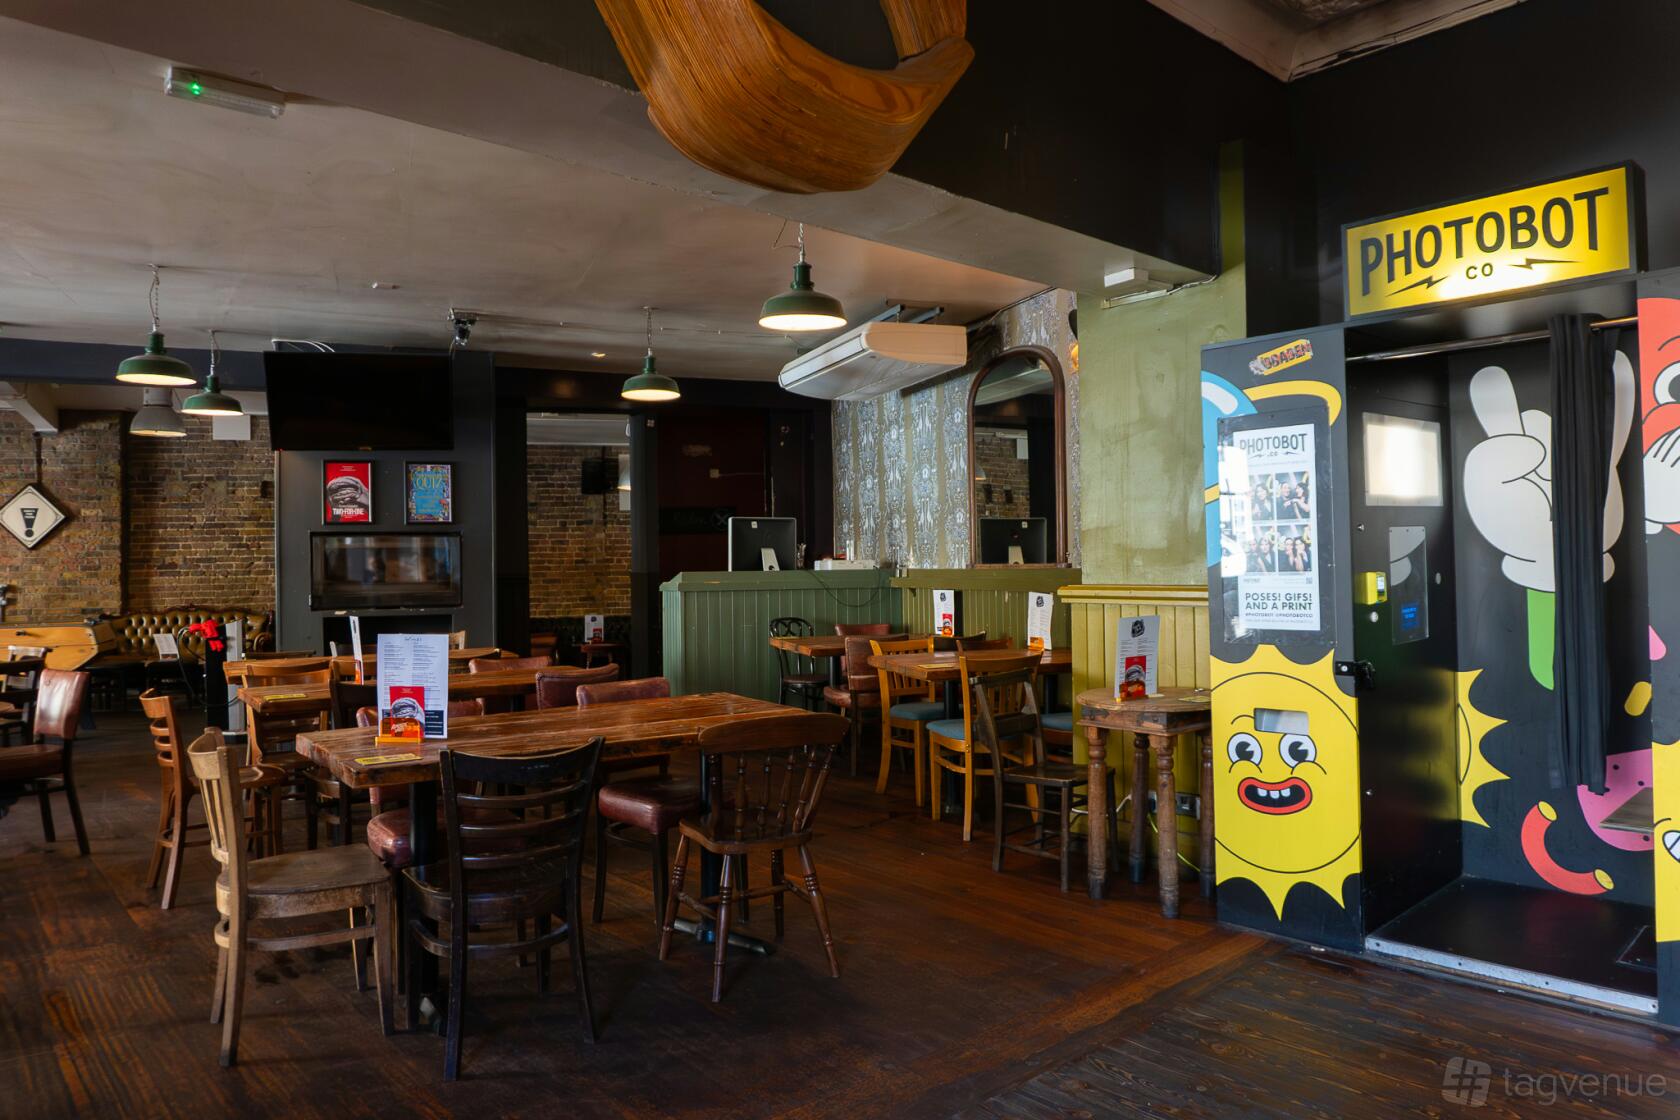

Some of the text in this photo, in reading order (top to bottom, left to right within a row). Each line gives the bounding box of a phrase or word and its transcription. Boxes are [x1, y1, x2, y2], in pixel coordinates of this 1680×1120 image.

[1360, 186, 1609, 297] PHOTOBOT
[1465, 262, 1494, 280] CO
[1240, 433, 1308, 455] PHOTOBOT
[1245, 592, 1312, 602] POSES! GIFS!
[1245, 601, 1313, 611] AND A PRINT
